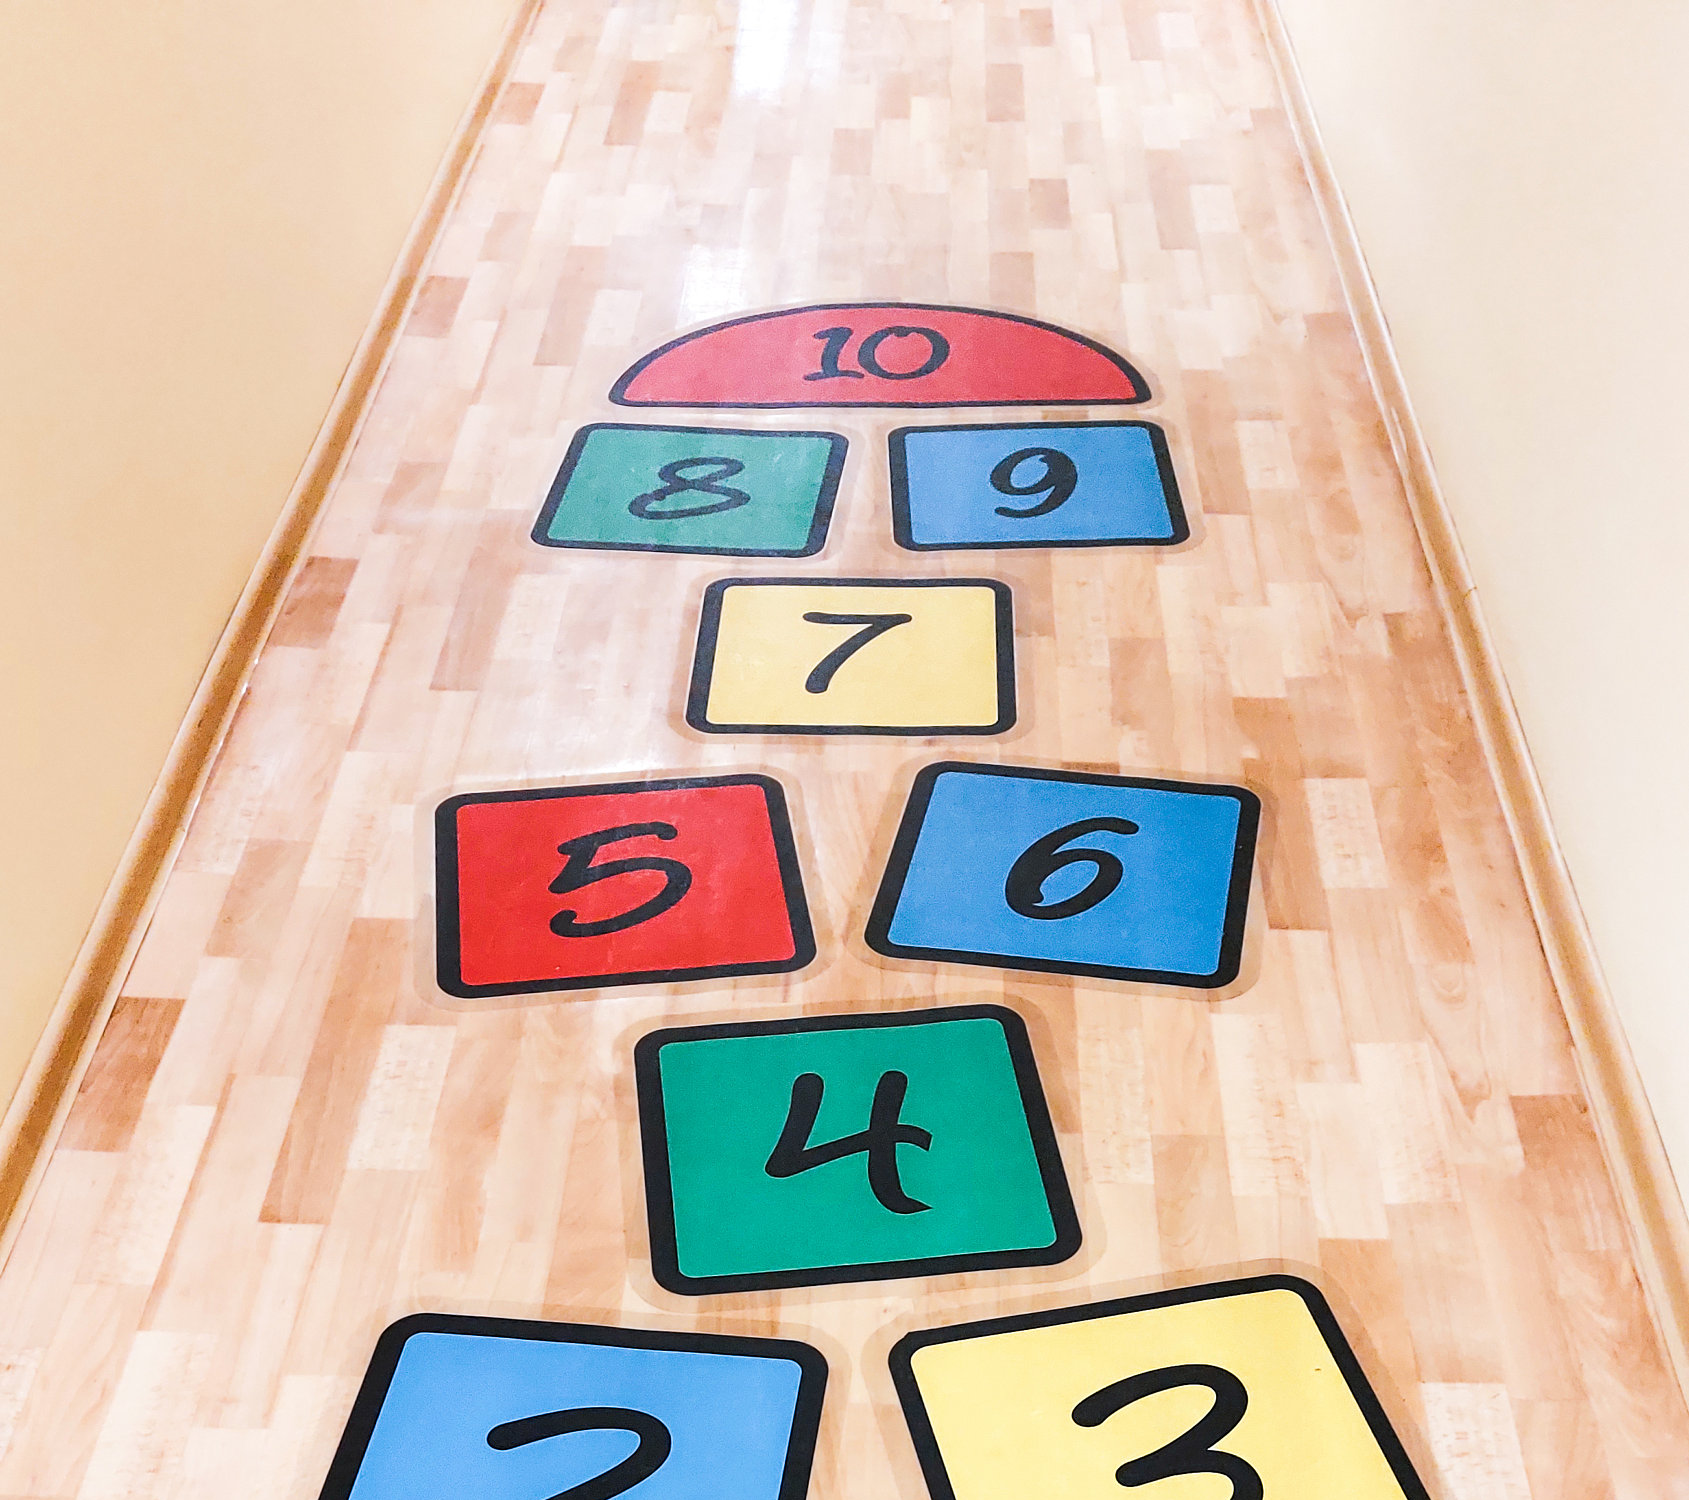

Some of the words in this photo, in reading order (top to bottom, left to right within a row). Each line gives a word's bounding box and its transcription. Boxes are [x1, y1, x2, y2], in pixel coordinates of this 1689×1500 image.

[804, 326, 950, 381] 10
[628, 457, 751, 520] 8
[990, 448, 1078, 518] 9
[803, 612, 912, 694] 7
[548, 822, 692, 937] 5
[1005, 817, 1139, 920] 6
[765, 1071, 932, 1214] 4
